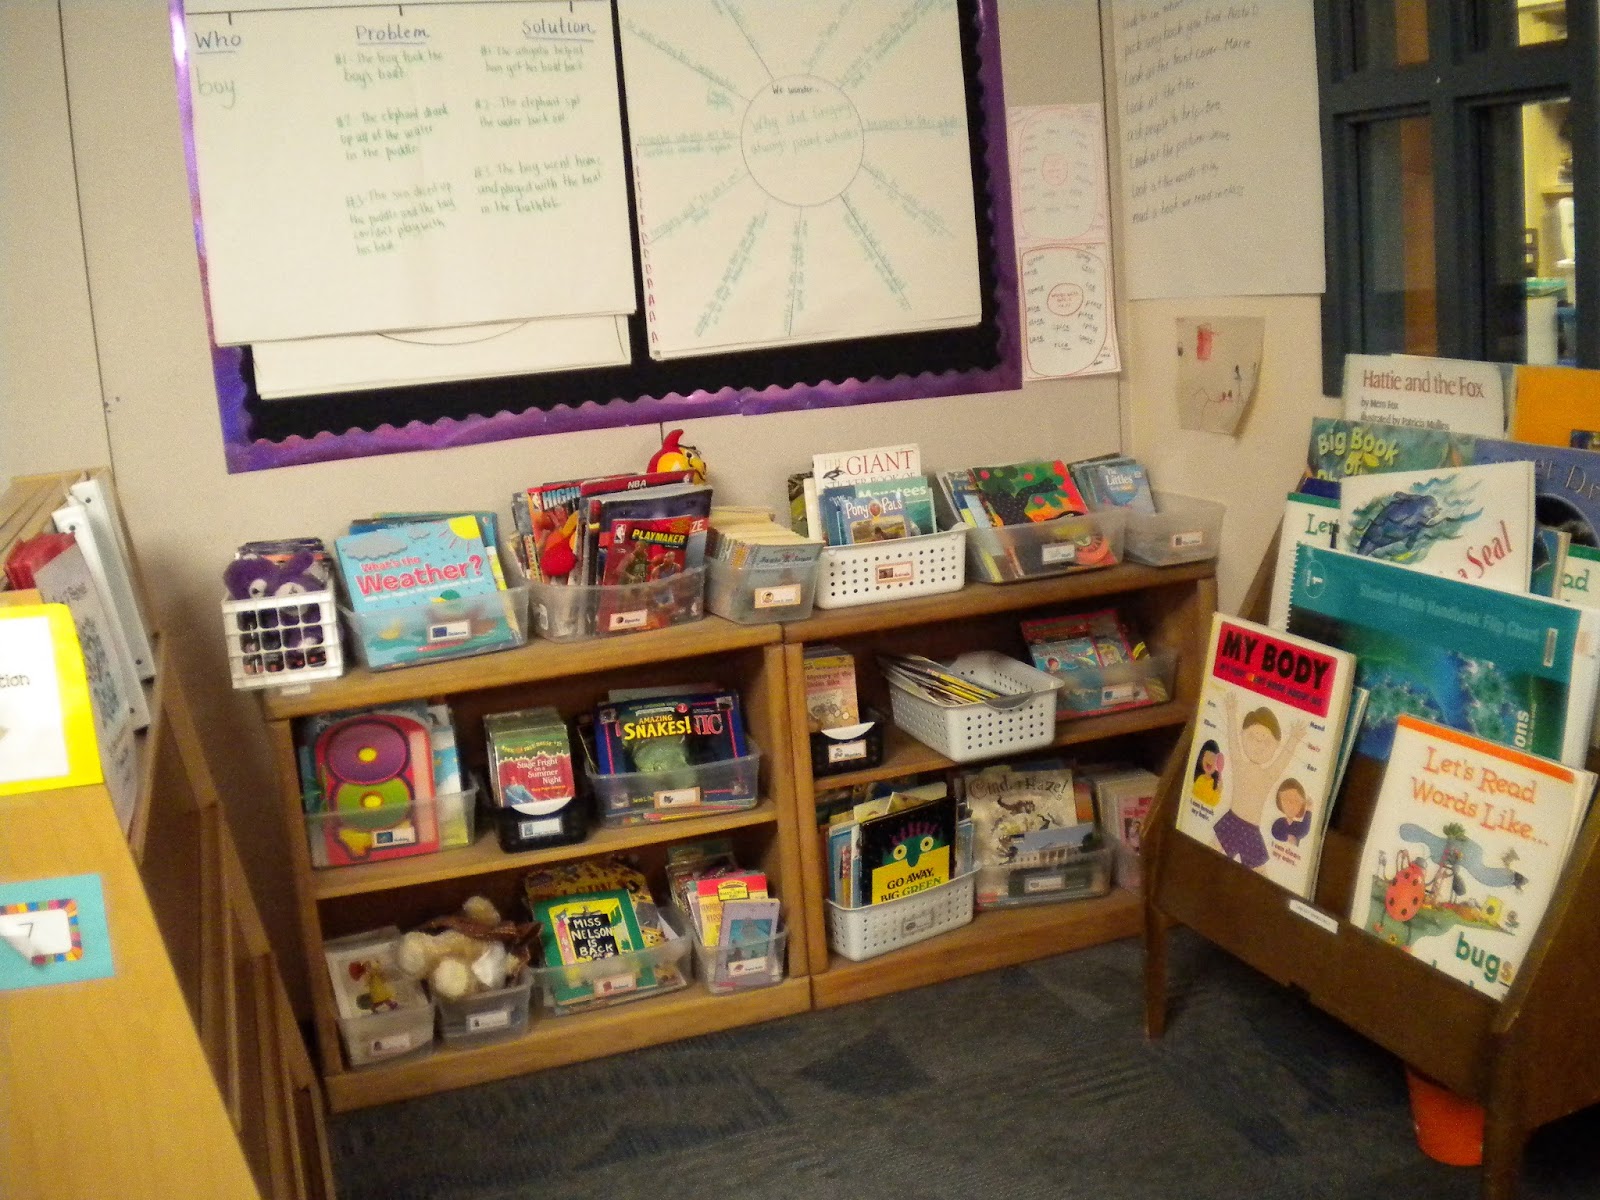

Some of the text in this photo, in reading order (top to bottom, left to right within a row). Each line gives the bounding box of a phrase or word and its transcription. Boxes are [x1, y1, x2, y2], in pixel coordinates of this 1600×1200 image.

[356, 24, 429, 41] Problem
[522, 17, 595, 34] Solution
[194, 31, 242, 48] Who
[196, 66, 236, 109] boy
[1363, 369, 1485, 398] Hattie and the Fox
[1318, 426, 1399, 466] Big Book
[846, 450, 914, 476] GIANT
[628, 480, 647, 490] NBA
[845, 497, 903, 520] Pony Pals
[632, 529, 686, 544] PLAYMAKER
[1466, 519, 1512, 579] Seal
[361, 557, 421, 573] What's the
[356, 555, 483, 596] Weather?
[1222, 630, 1259, 665] MY
[1262, 643, 1330, 690] BODY
[623, 716, 692, 740] SNAKES!
[640, 714, 673, 726] AMAZING
[517, 758, 558, 769] Stage Fright
[528, 770, 558, 778] Summer
[543, 775, 562, 785] Night
[1423, 747, 1539, 804] Let's Read
[1411, 777, 1478, 819] Words
[881, 876, 941, 902] BIG GREEN
[887, 878, 904, 889] GO
[18, 922, 33, 938] 7
[573, 917, 601, 928] MISS
[571, 927, 613, 941] NELSON
[579, 944, 614, 956] BACK
[587, 939, 597, 947] IS
[1456, 931, 1513, 983] bugs
